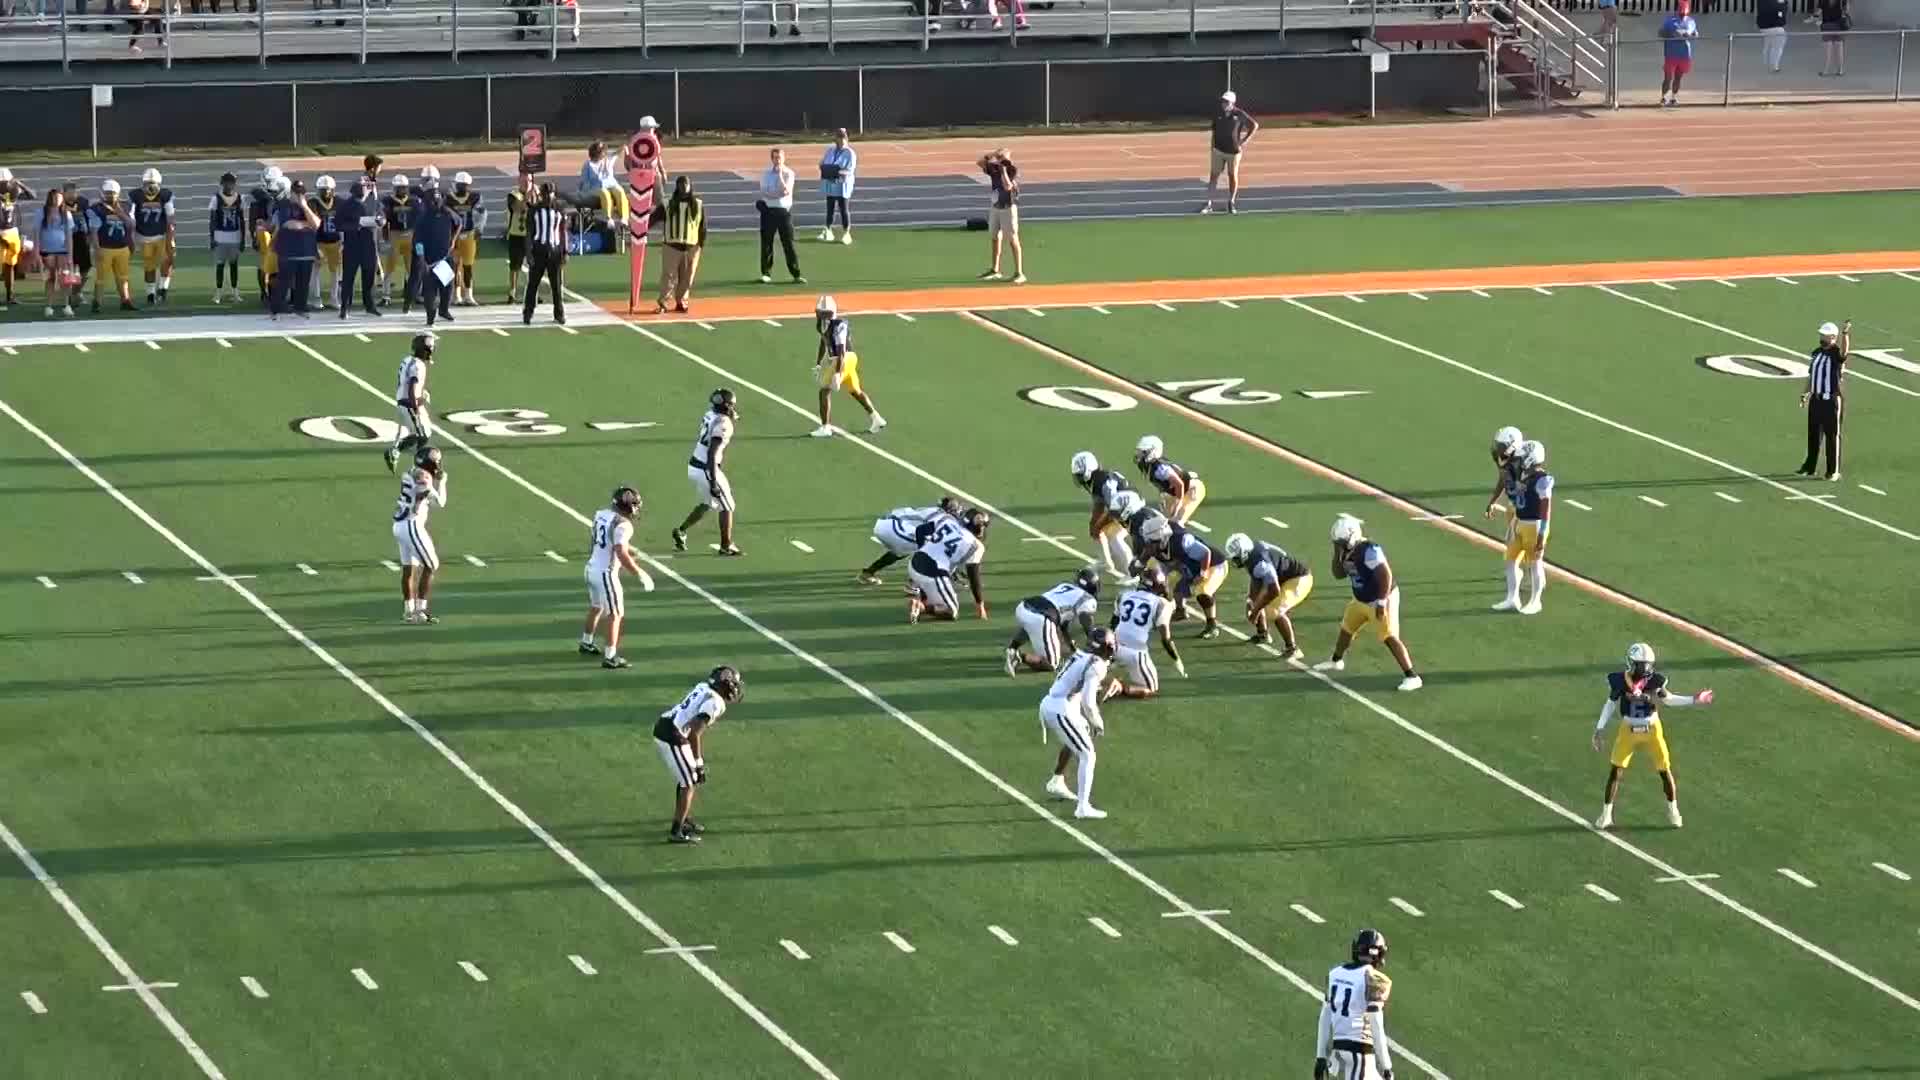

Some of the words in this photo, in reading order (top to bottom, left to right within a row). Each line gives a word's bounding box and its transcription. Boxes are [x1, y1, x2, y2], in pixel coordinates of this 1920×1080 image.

[522, 129, 542, 154] 2
[143, 208, 161, 222] 77
[1121, 600, 1151, 626] 33
[1330, 984, 1352, 1017] 11
